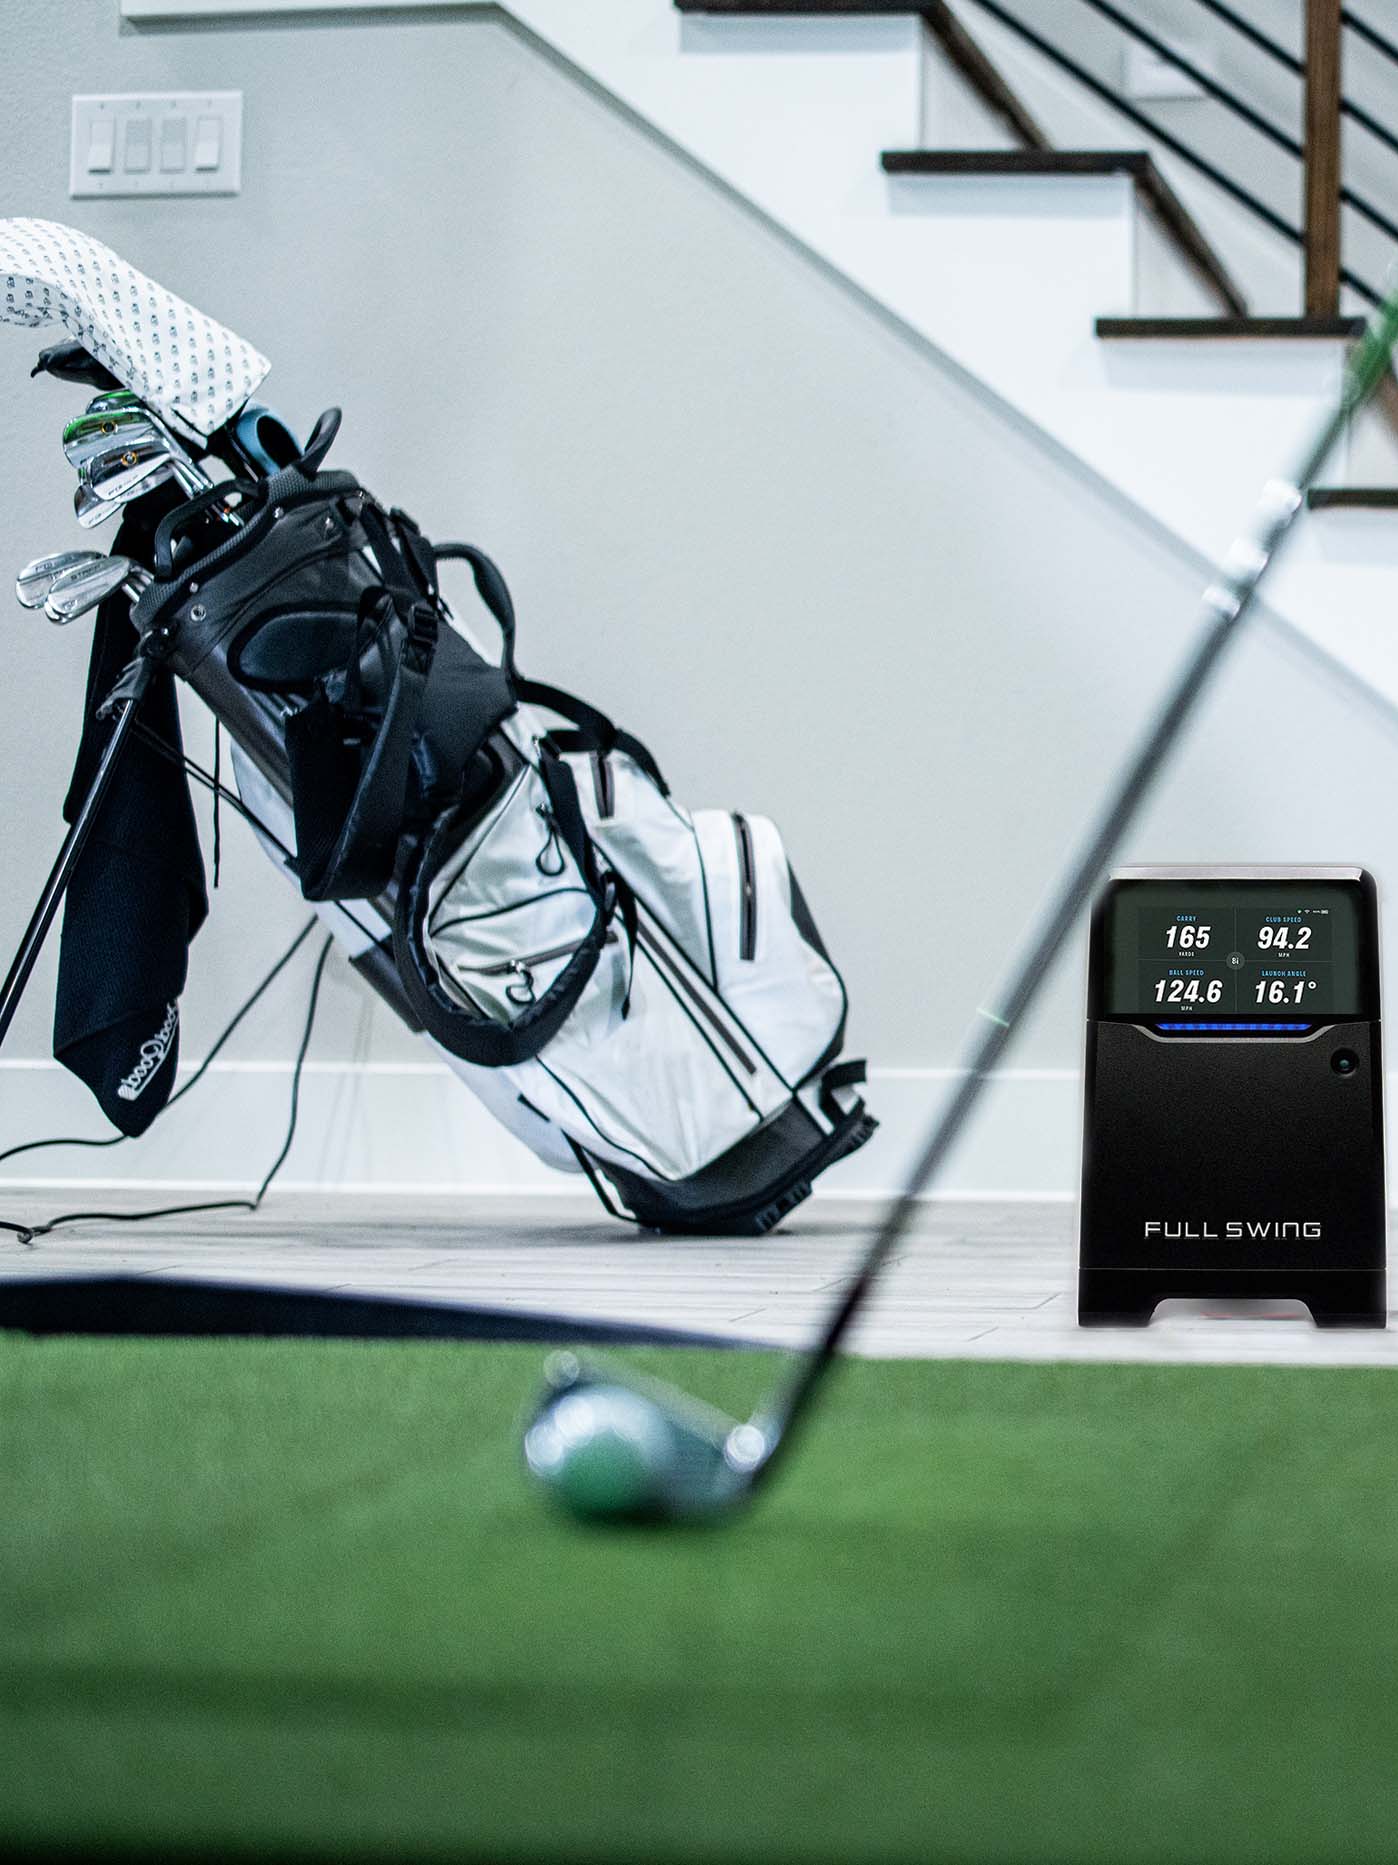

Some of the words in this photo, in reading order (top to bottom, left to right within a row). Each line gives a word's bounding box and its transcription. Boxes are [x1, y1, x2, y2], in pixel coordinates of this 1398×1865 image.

[1166, 925, 1211, 949] 165
[1257, 926, 1312, 950] 94.2
[1155, 979, 1223, 1003] 124.6
[1255, 980, 1317, 1004] 16.1°
[1145, 1221, 1218, 1238] FULL
[1226, 1221, 1321, 1238] SWING
